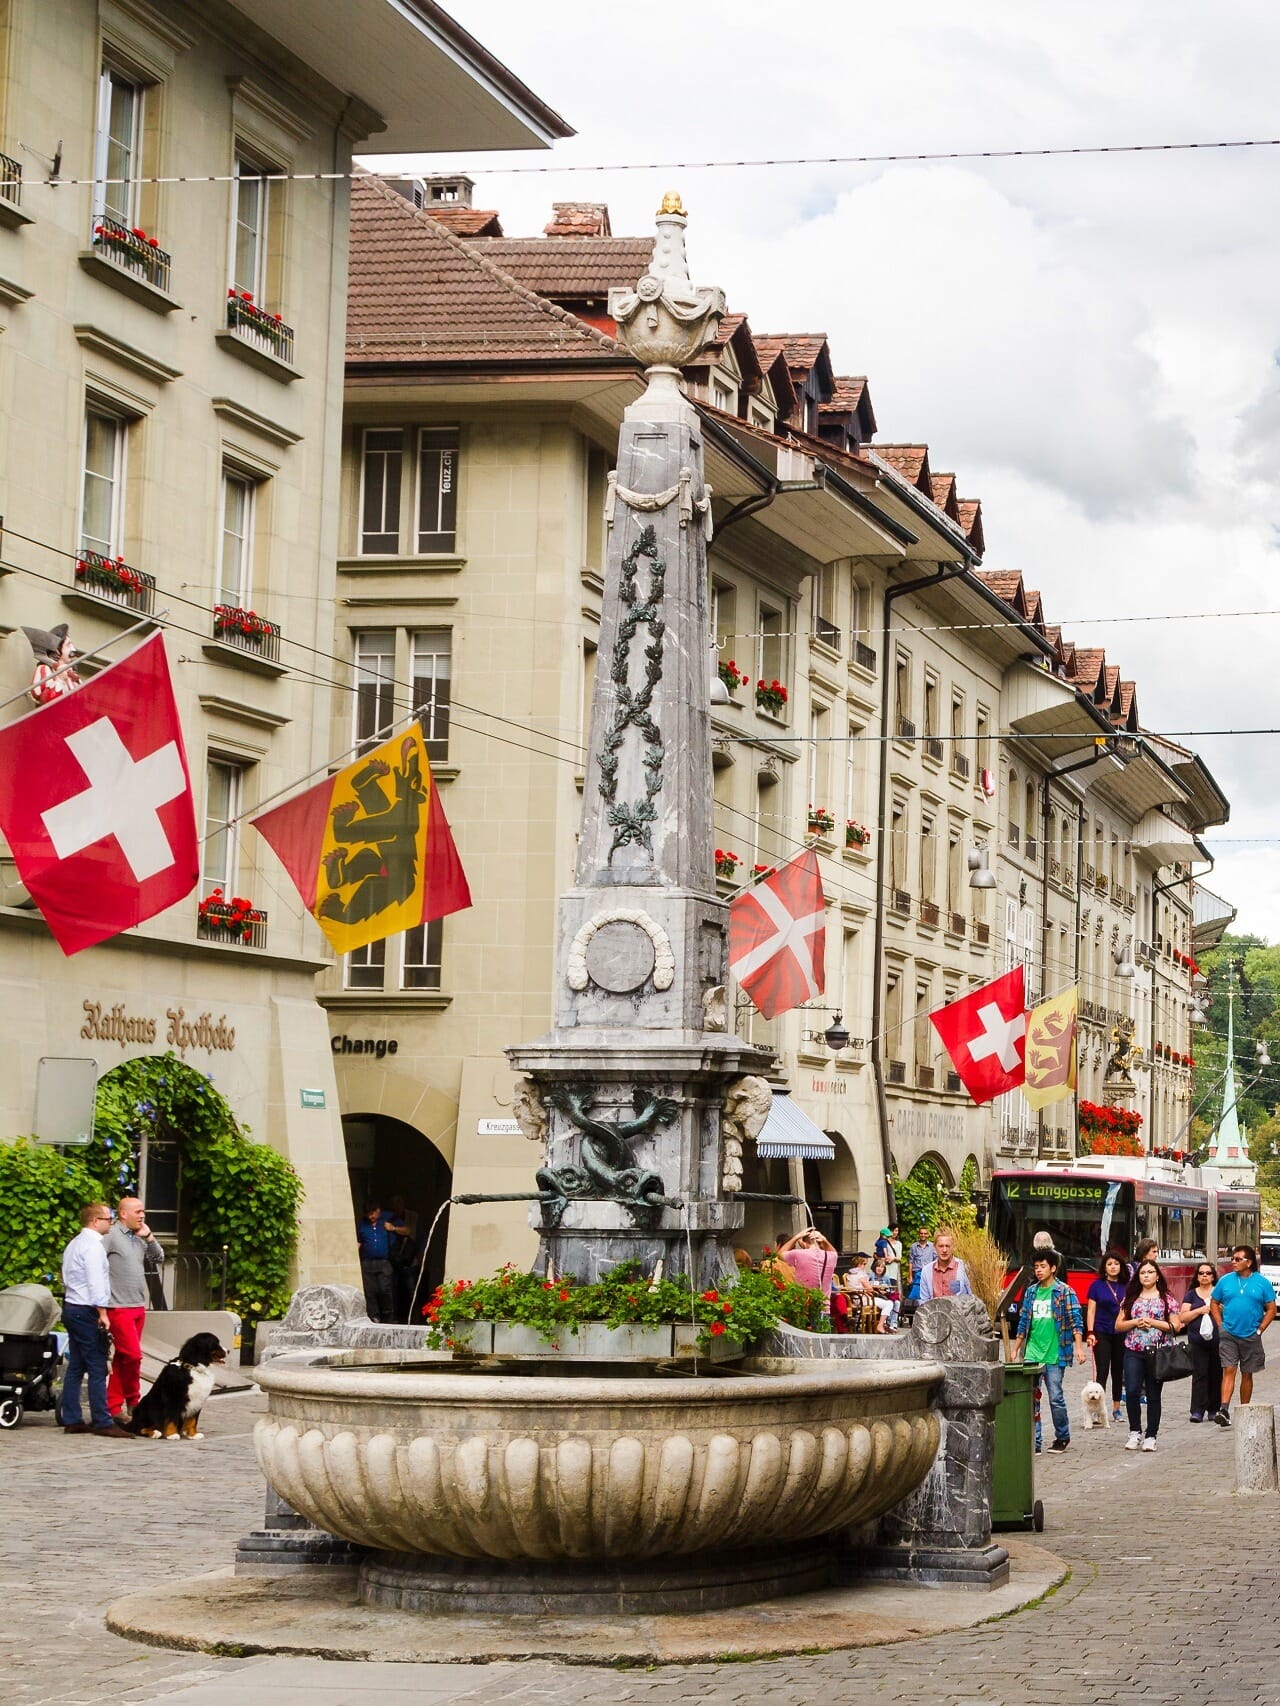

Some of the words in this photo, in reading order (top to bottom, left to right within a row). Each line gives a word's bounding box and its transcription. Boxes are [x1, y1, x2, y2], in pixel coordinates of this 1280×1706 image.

[441, 451, 452, 493] feuz.ch
[80, 999, 157, 1048] Rathaus
[166, 1007, 235, 1059] Apotheke
[330, 1034, 398, 1059] Change
[917, 1111, 926, 1137] DU
[928, 1113, 964, 1140] COMMERCE
[1006, 1181, 1020, 1197] 12
